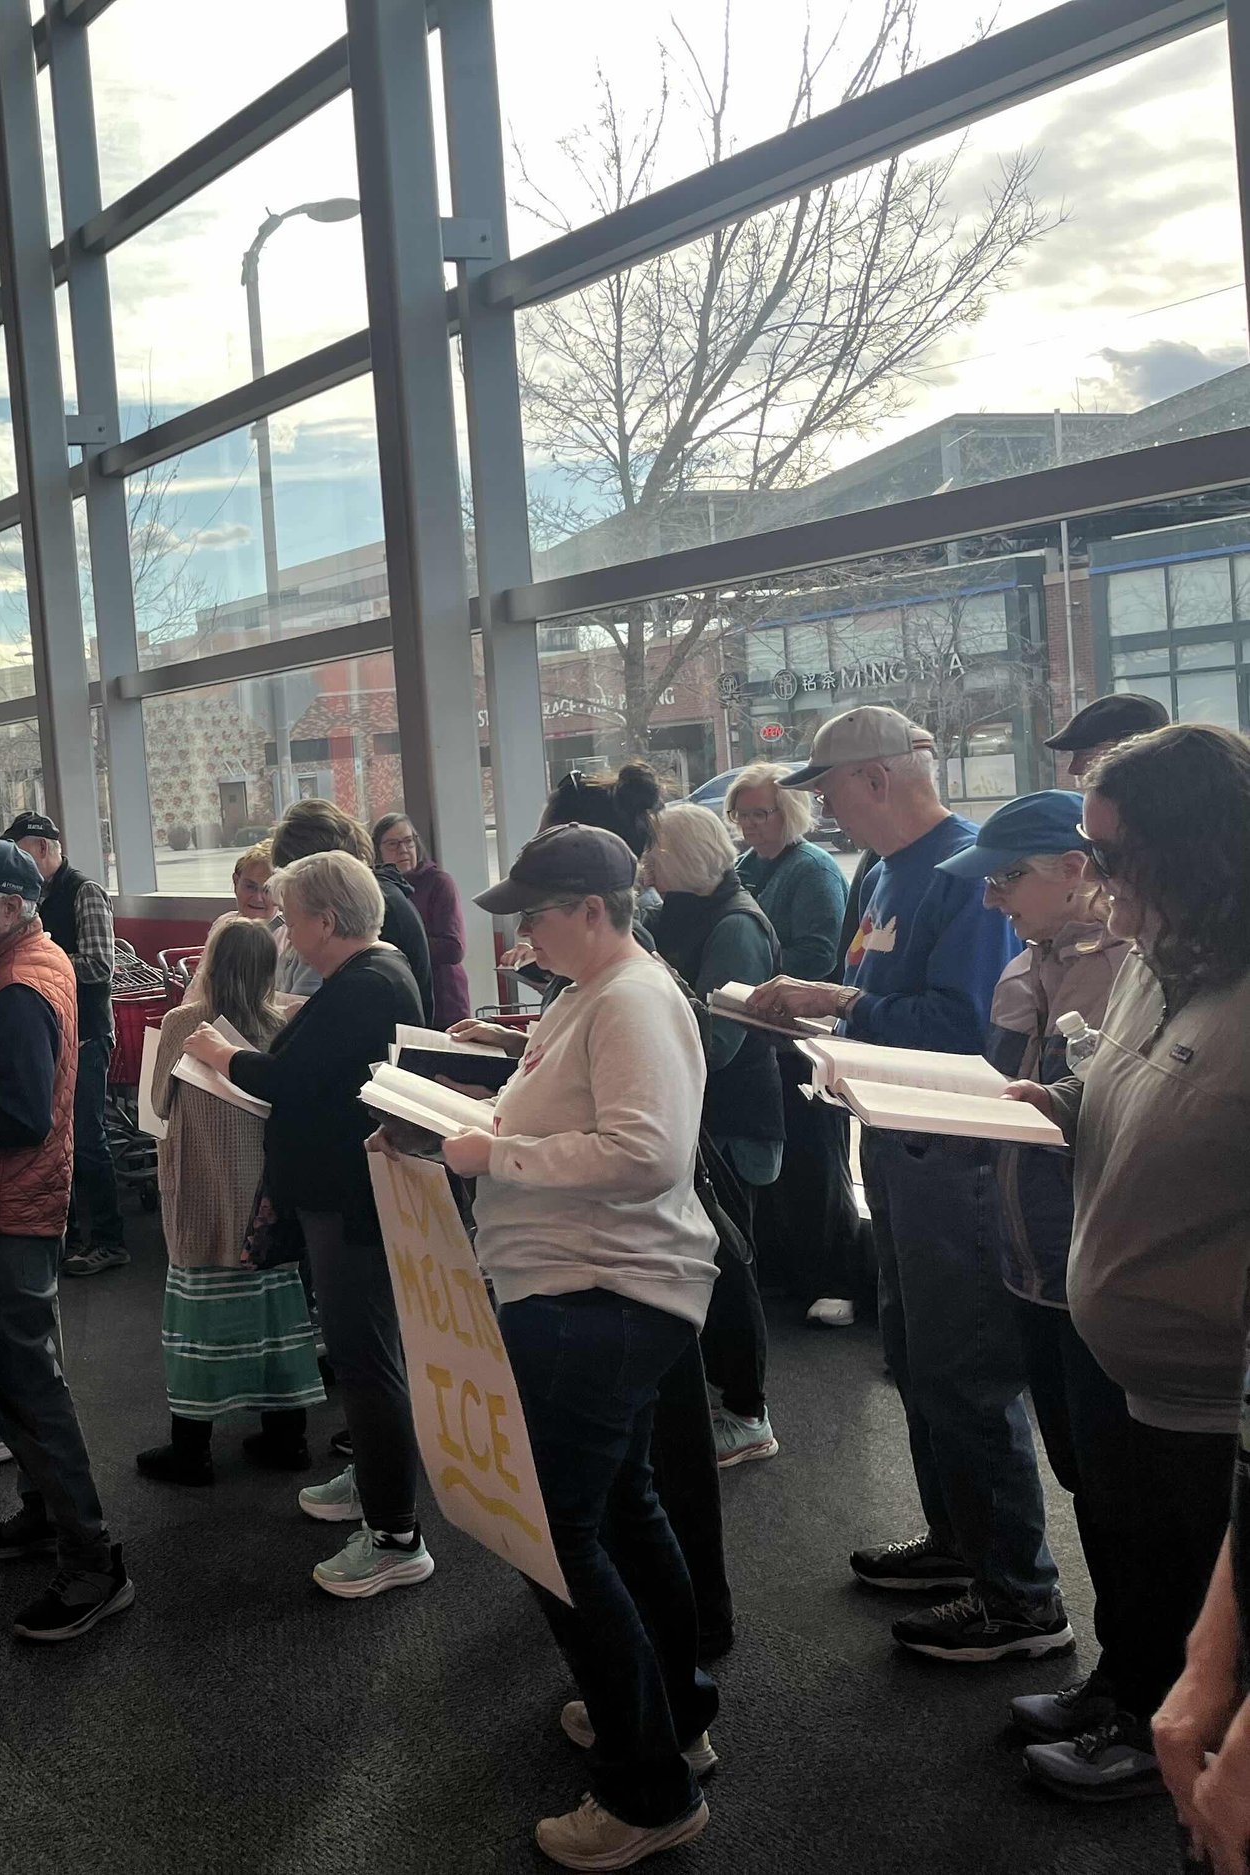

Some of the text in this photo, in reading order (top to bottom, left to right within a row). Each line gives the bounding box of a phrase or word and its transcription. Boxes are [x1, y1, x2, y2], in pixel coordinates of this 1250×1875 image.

[840, 660, 908, 688] MING
[762, 725, 783, 737] OPEN
[426, 1363, 521, 1494] ICE
